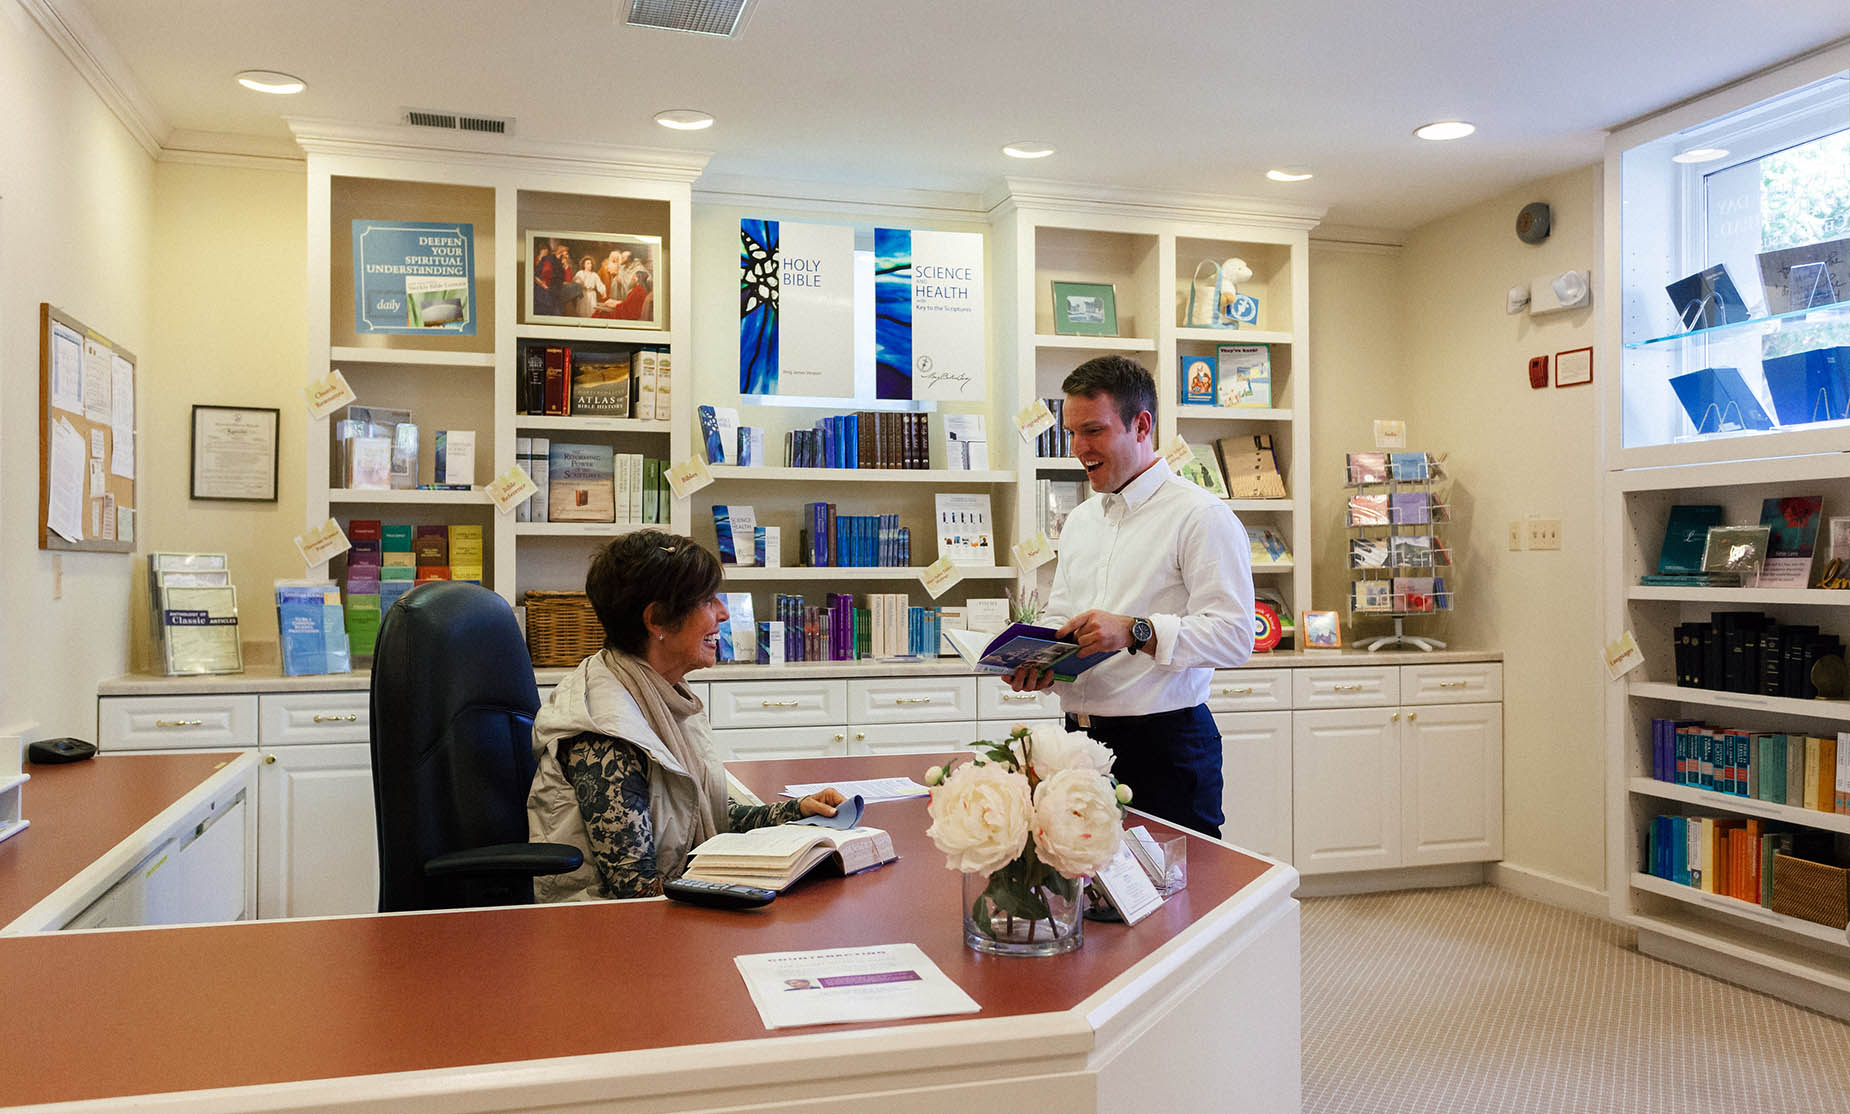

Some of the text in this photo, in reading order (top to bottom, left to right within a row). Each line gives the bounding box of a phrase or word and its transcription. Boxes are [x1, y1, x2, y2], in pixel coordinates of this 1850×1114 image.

[419, 237, 462, 246] DEEPEN
[431, 247, 463, 256] YOUR
[405, 256, 463, 266] SPIRITUAL
[783, 258, 821, 272] HOLY
[366, 264, 464, 276] UNDERSTANDING
[916, 266, 972, 280] SCIENCE
[783, 272, 822, 288] BIBLE
[916, 285, 968, 300] HEALTH
[376, 299, 400, 312] daily
[578, 396, 616, 404] ATLAS
[172, 616, 206, 625] Classic
[1610, 648, 1634, 666] Languages
